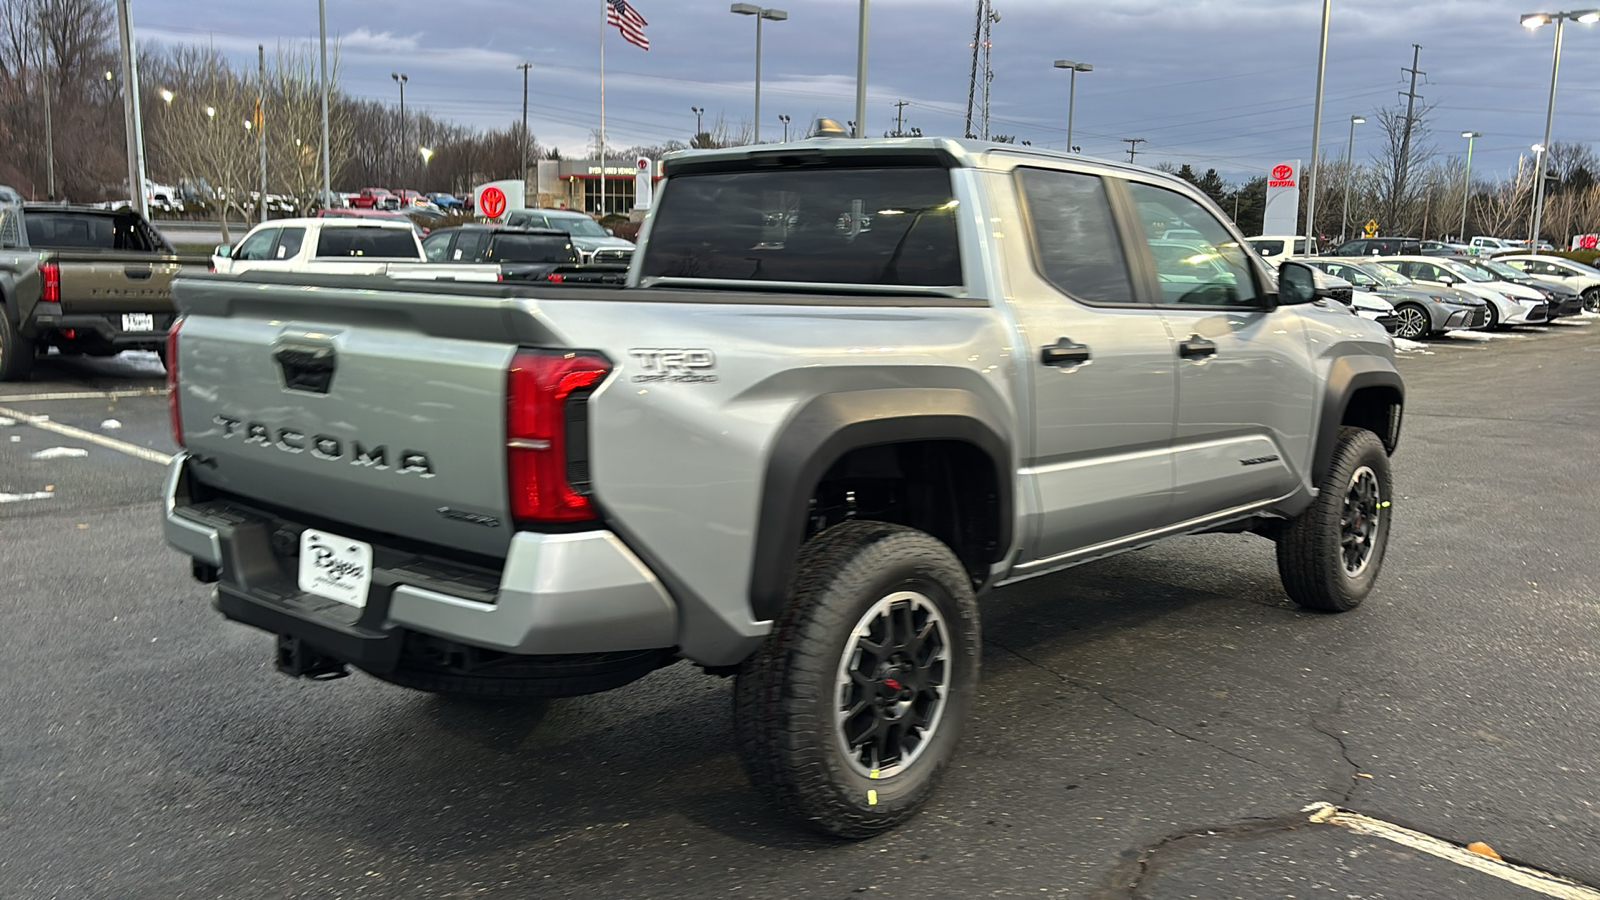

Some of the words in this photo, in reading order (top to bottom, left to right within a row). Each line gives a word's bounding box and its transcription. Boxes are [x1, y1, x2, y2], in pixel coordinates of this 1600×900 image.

[588, 166, 604, 175] BYER
[604, 167, 617, 175] USED
[617, 167, 637, 175] VEHICLE
[1268, 179, 1295, 187] TOYOTA
[628, 347, 716, 374] TRD
[212, 415, 436, 479] TACOMA
